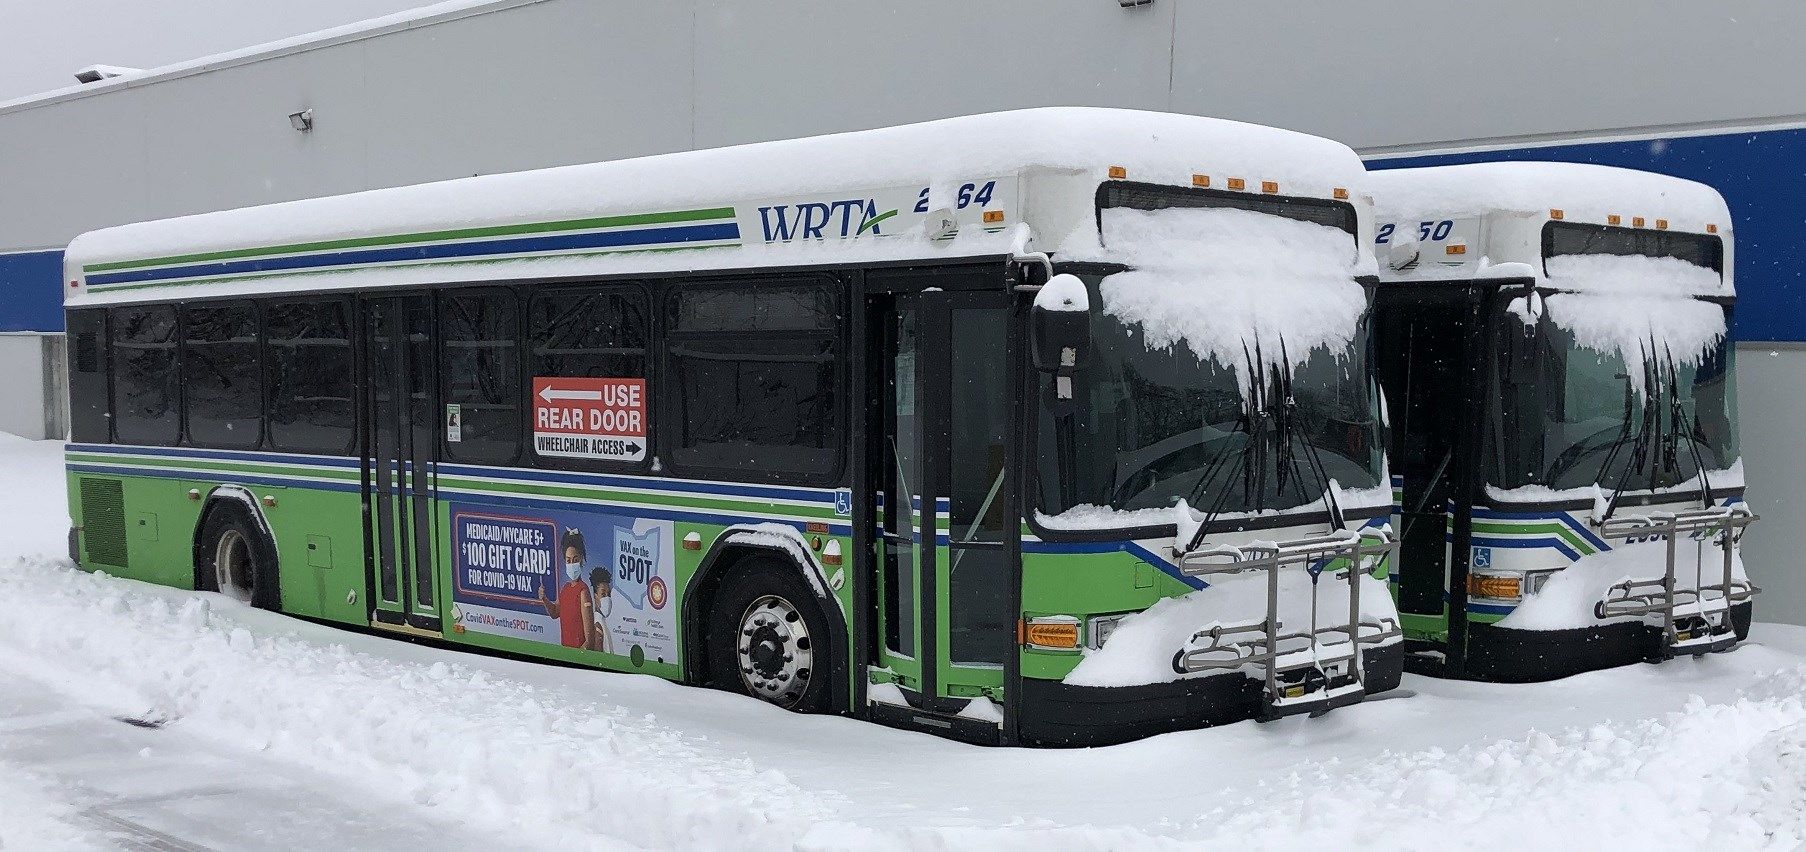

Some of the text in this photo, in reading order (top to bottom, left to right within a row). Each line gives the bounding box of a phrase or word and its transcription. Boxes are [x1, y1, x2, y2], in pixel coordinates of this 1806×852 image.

[913, 181, 996, 212] 264
[758, 199, 898, 243] WRTA
[1375, 220, 1453, 243] 250
[604, 384, 640, 407] USE
[538, 407, 640, 432] REAR DOOR
[538, 437, 624, 455] WHEELCHAIR ACCESS
[466, 522, 544, 546] MEDICAID/MYCARE 5+
[462, 541, 550, 575] $100 GIFT CARD!
[620, 540, 649, 557] VAX on the
[468, 569, 532, 592] FOR COVID-19 VAX
[619, 554, 652, 585] SPOT
